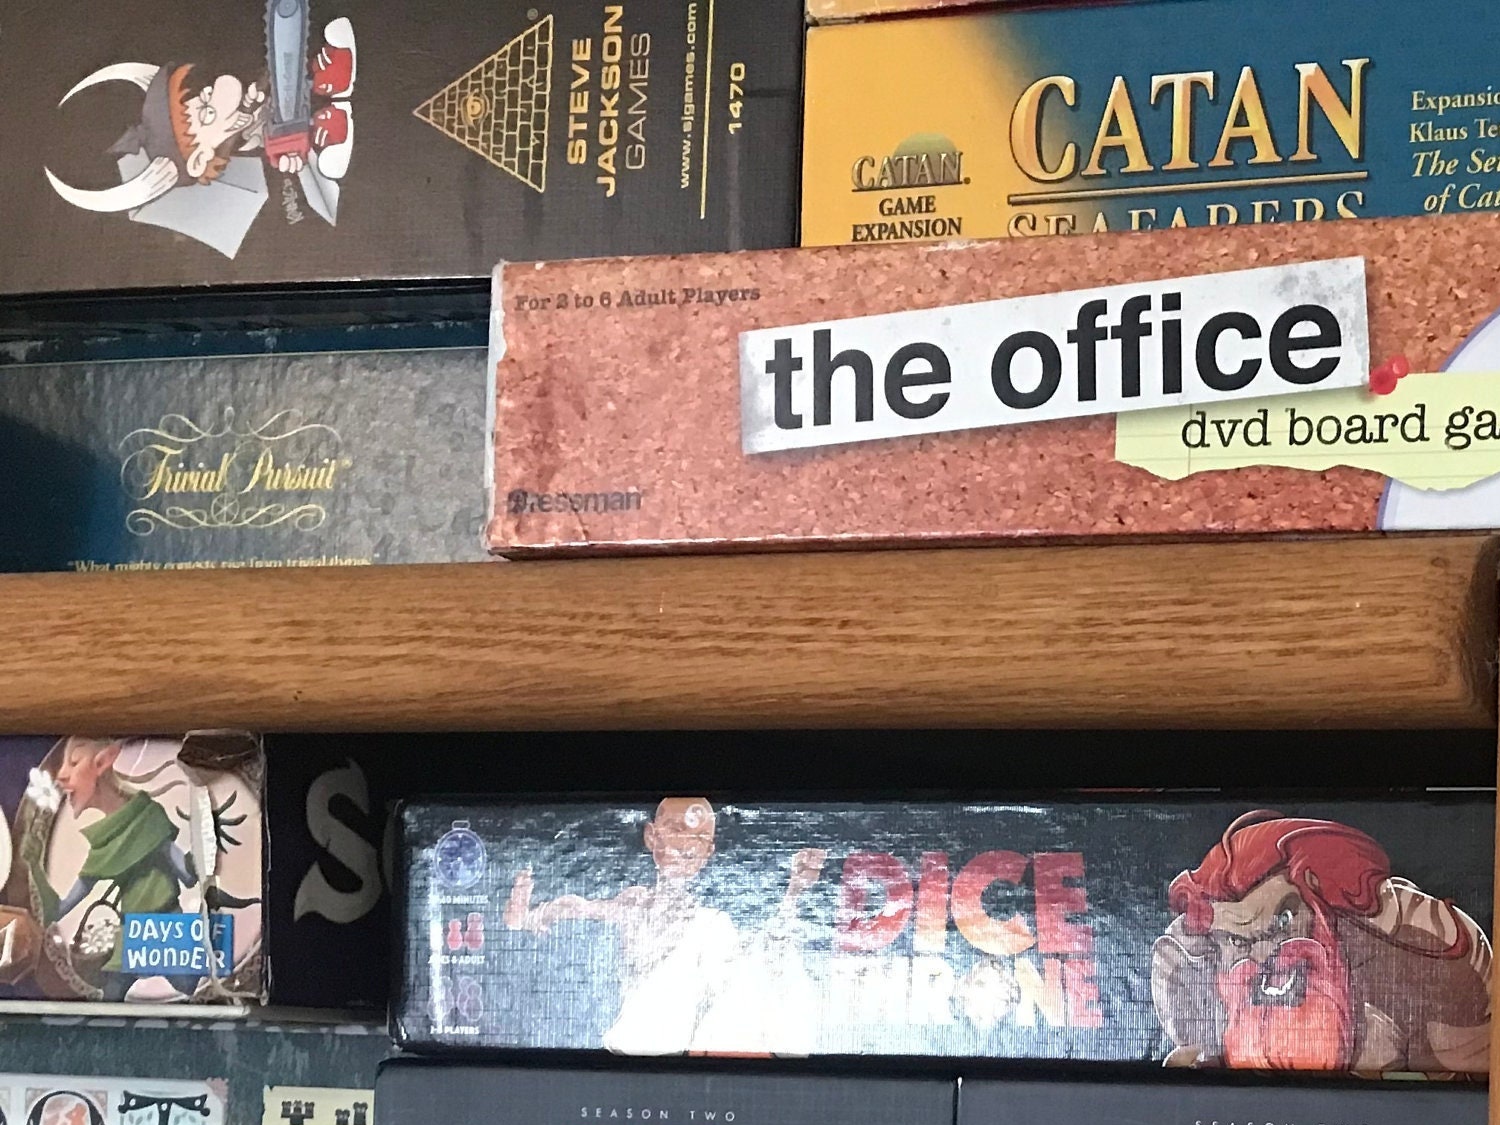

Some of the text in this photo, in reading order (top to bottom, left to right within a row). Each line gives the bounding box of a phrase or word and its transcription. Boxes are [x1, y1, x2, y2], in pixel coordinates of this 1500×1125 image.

[567, 38, 592, 164] STEVE
[597, 5, 623, 198] JACKSON
[625, 33, 651, 170] GAMES
[681, 3, 697, 189] www.sjgames.com
[728, 62, 745, 135] 1470
[1009, 57, 1370, 183] CATAN
[1409, 120, 1468, 143] Klaus
[851, 150, 964, 190] CATAN
[1411, 150, 1459, 177] The
[878, 195, 936, 216] GAME
[1423, 183, 1457, 215] of
[852, 217, 963, 242] EXPANSION
[514, 287, 761, 311] For 2 to 6 Adult Players
[764, 291, 1344, 431] the office
[1181, 408, 1272, 449] dvd
[1285, 404, 1430, 446] board
[135, 443, 338, 500] Trivial Pursuit
[834, 850, 1095, 955] DICE
[128, 918, 226, 942] DAYS OF
[127, 946, 226, 970] WONDER
[581, 1106, 737, 1122] SEASON TWO
